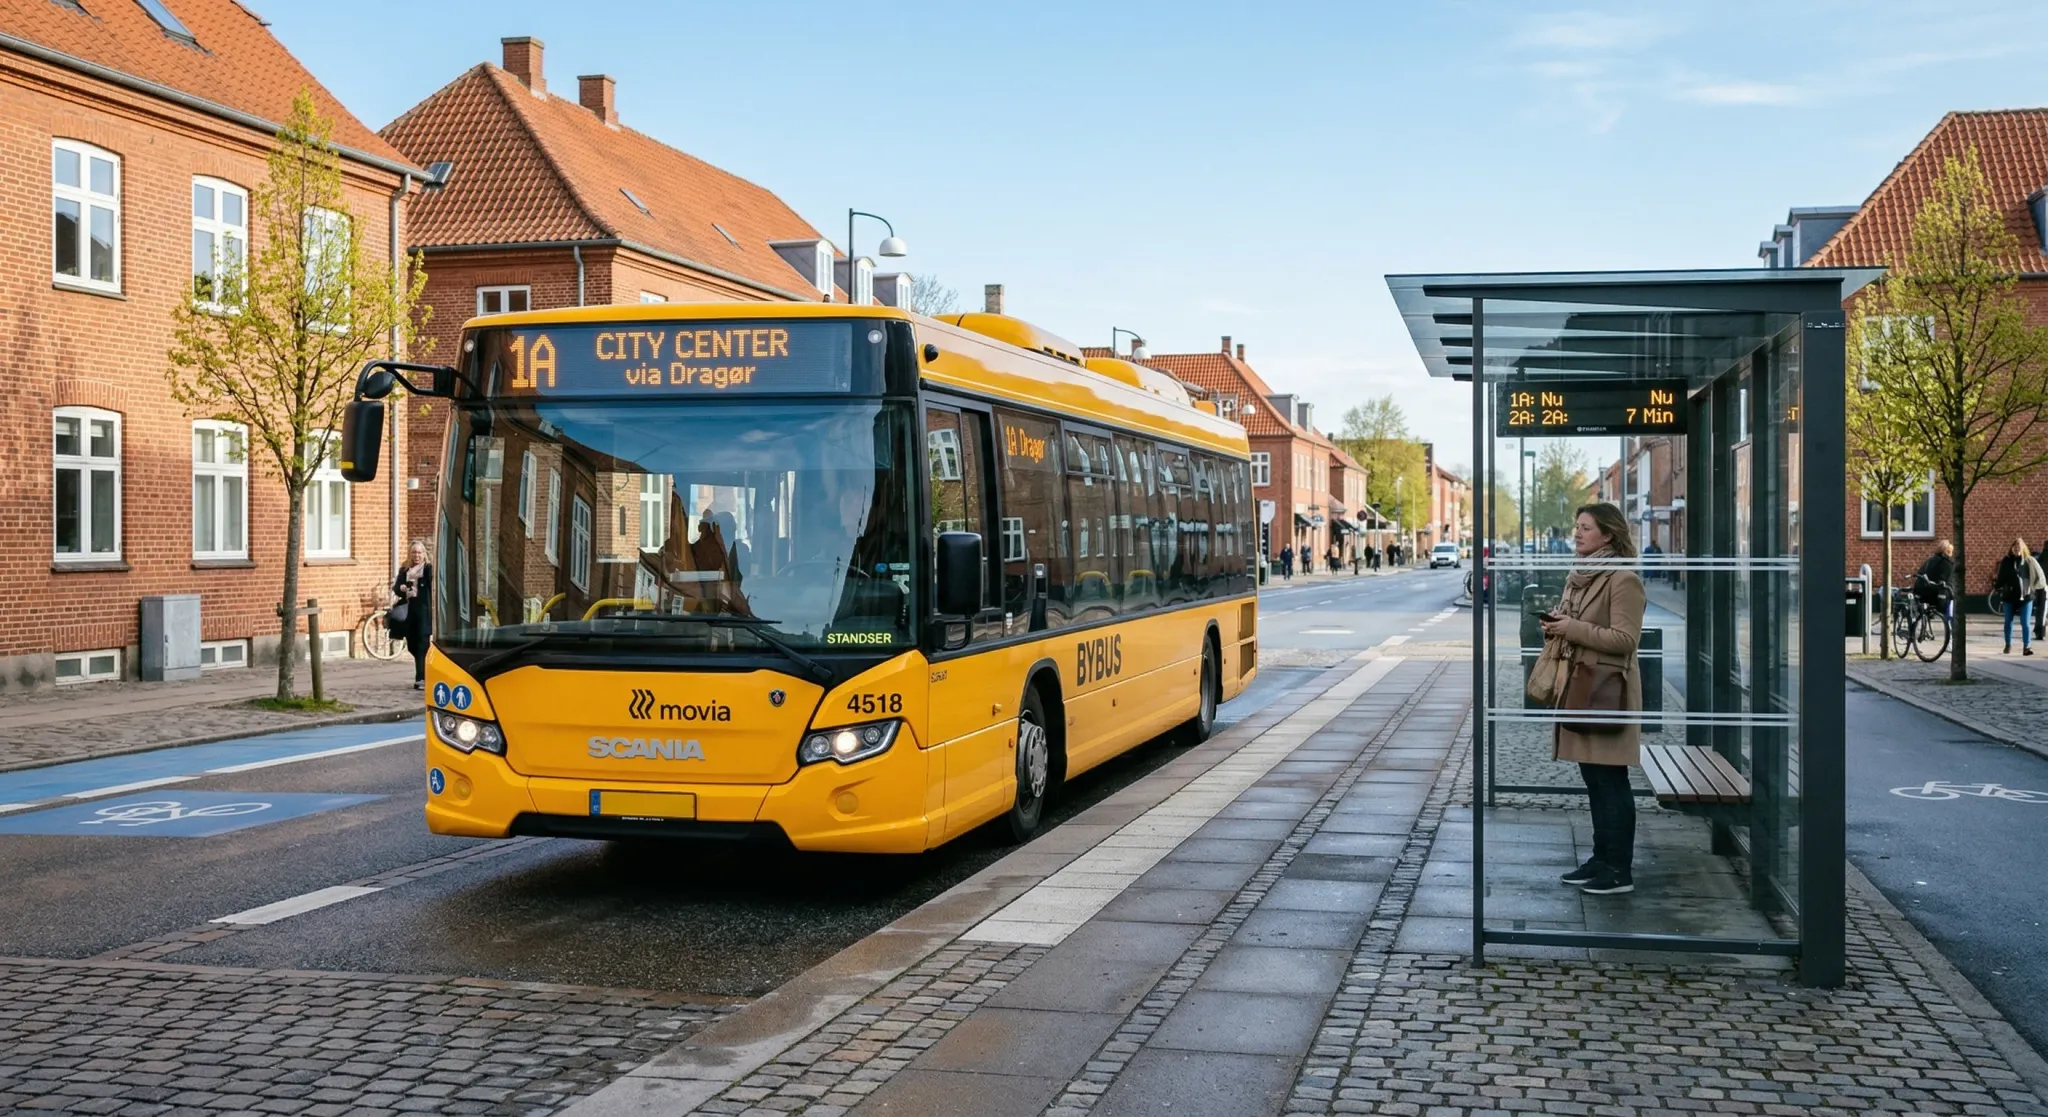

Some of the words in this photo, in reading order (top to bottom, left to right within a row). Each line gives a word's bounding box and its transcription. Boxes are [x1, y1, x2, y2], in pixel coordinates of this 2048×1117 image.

[596, 331, 665, 360] CITY
[675, 328, 789, 359] CENTER
[509, 334, 556, 388] 1A
[625, 362, 661, 385] via
[670, 361, 756, 389] Dragør
[1510, 392, 1535, 407] 1A:
[1541, 391, 1563, 407] Nu
[1651, 389, 1673, 405] Nu
[1509, 410, 1535, 425] 2A:
[1541, 409, 1568, 425] 2A:
[1626, 407, 1637, 424] 7
[1643, 407, 1674, 424] Min
[827, 633, 892, 644] STANDSER
[1076, 633, 1122, 687] BYBUS
[660, 699, 731, 722] movia
[846, 693, 903, 714] 4518
[587, 736, 706, 761] SCANIA
